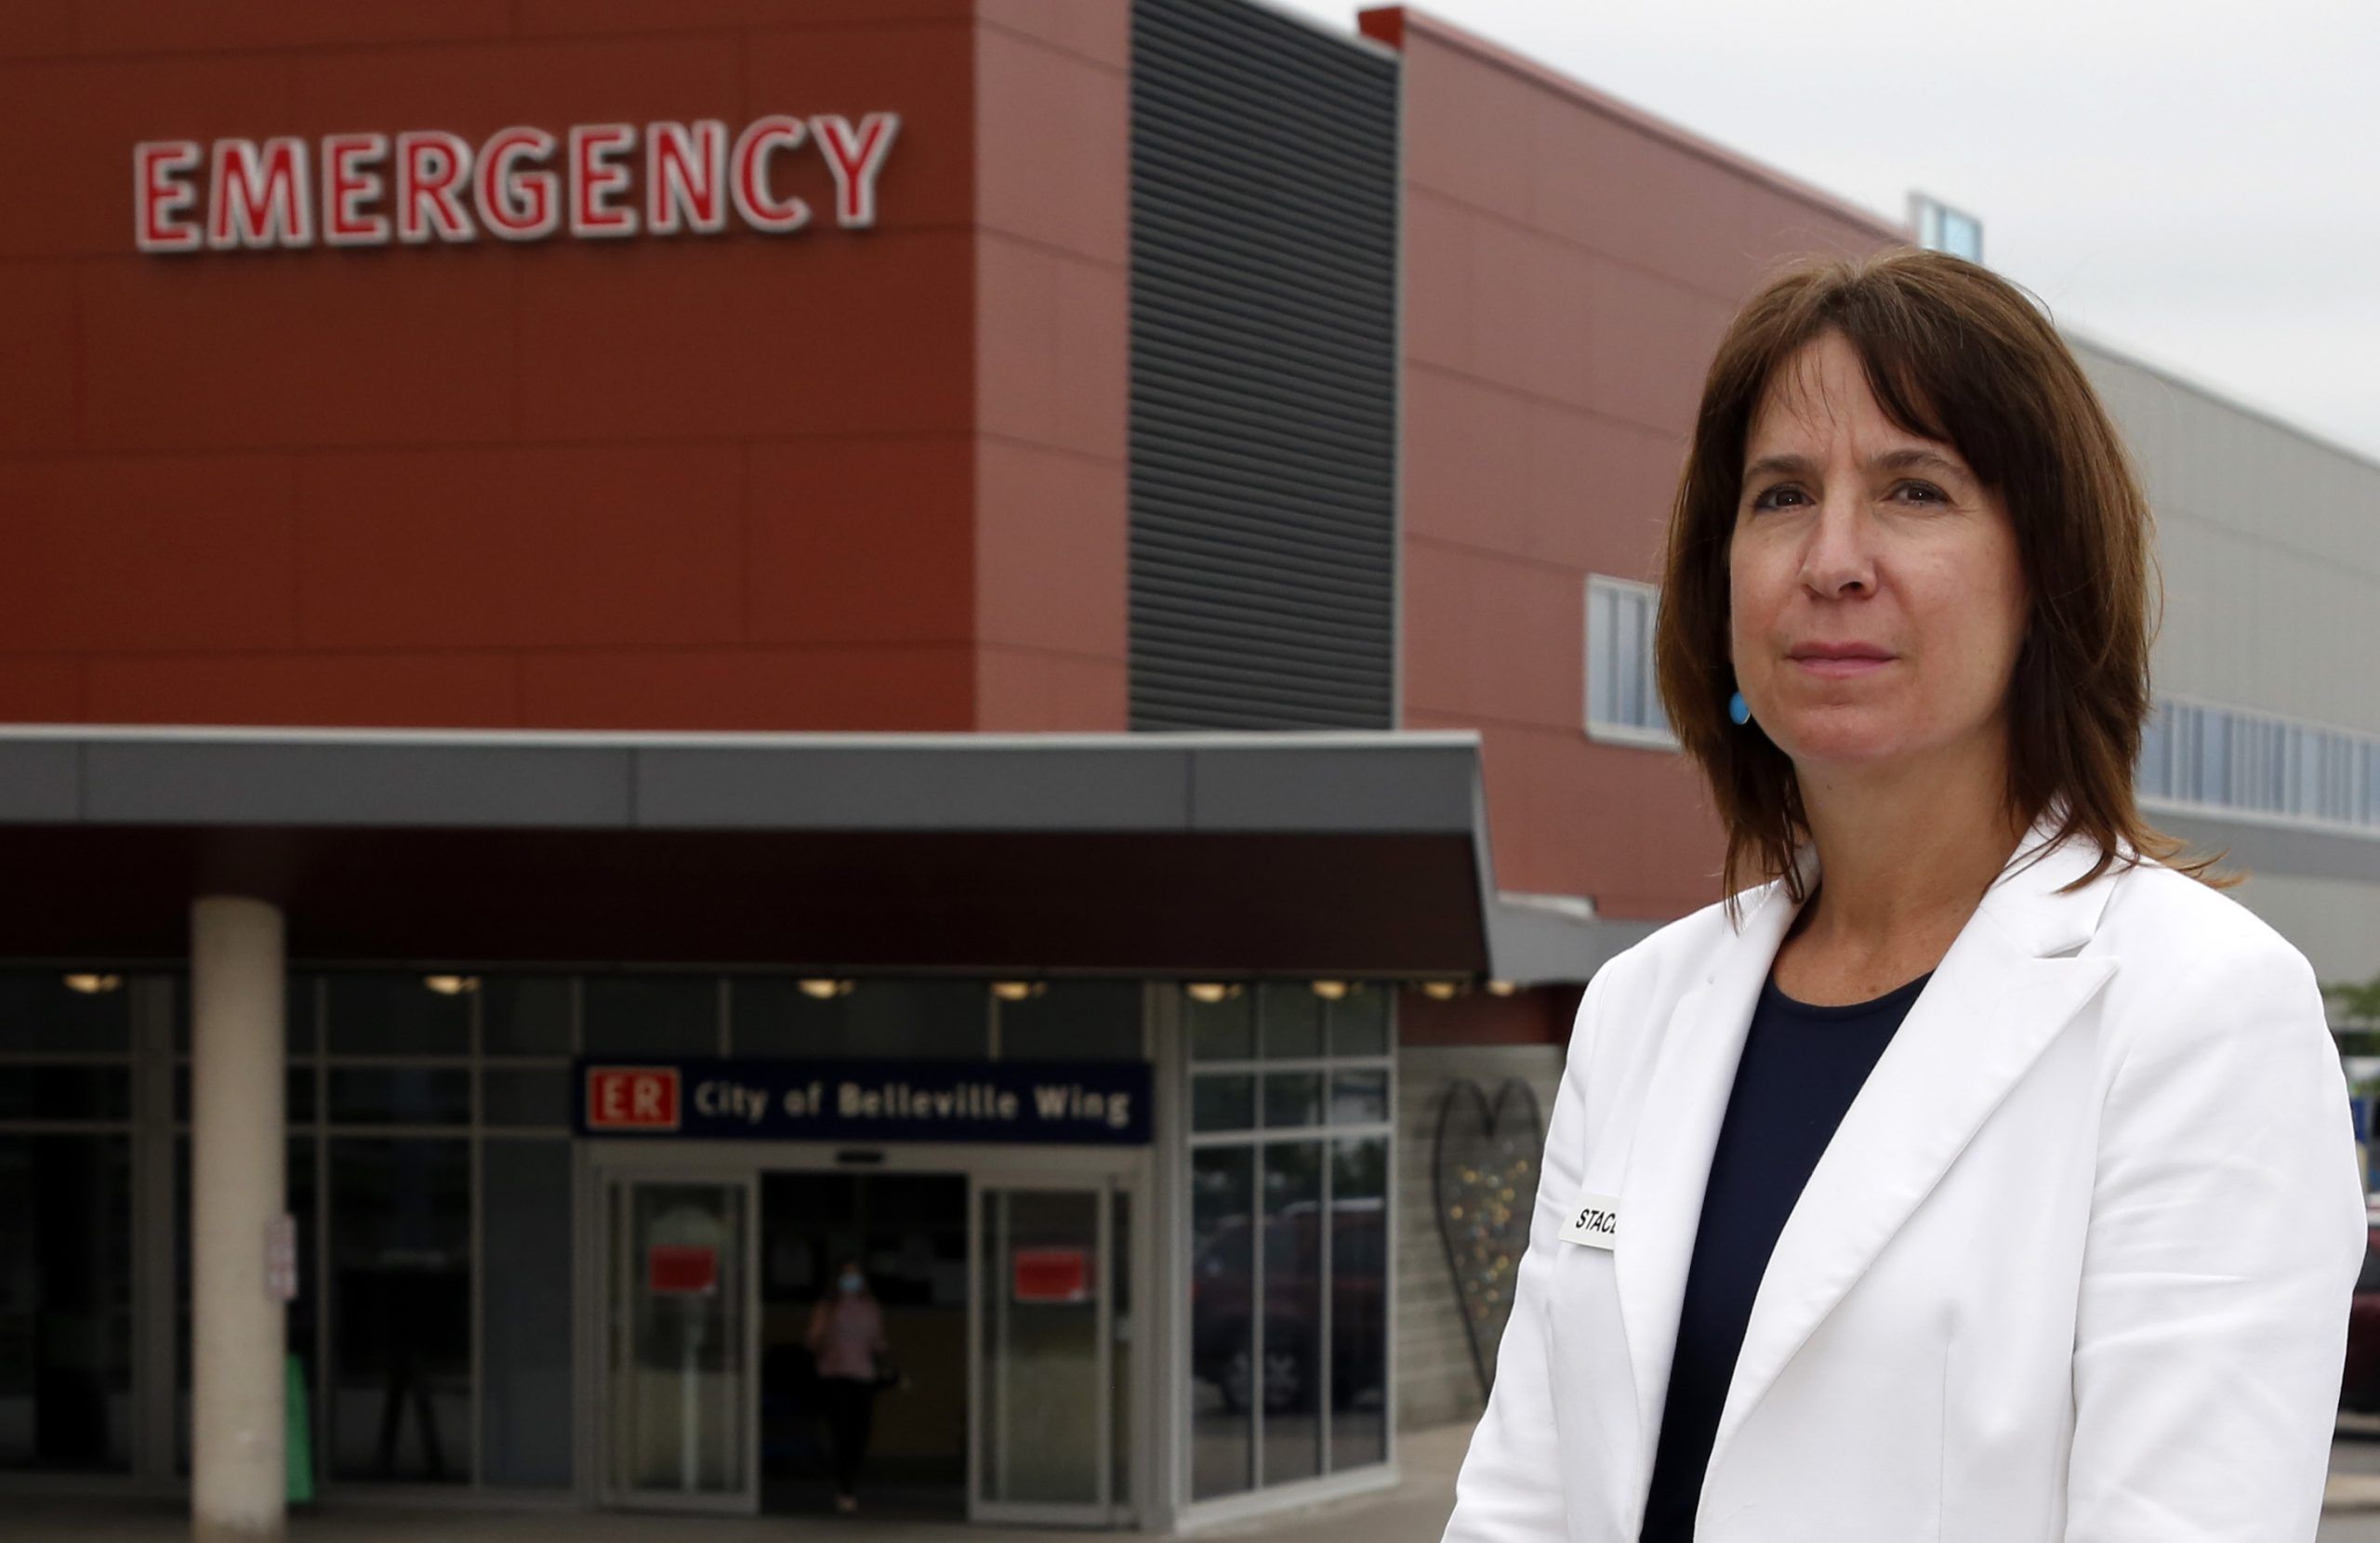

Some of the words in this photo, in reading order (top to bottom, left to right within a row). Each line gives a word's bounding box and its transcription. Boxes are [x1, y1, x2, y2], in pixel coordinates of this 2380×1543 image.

[135, 112, 900, 253] EMERGENCY
[602, 1076, 668, 1122] ER
[694, 1080, 770, 1123] City
[783, 1081, 825, 1116] of
[839, 1081, 1020, 1119] Belleville
[1034, 1084, 1132, 1128] Wing
